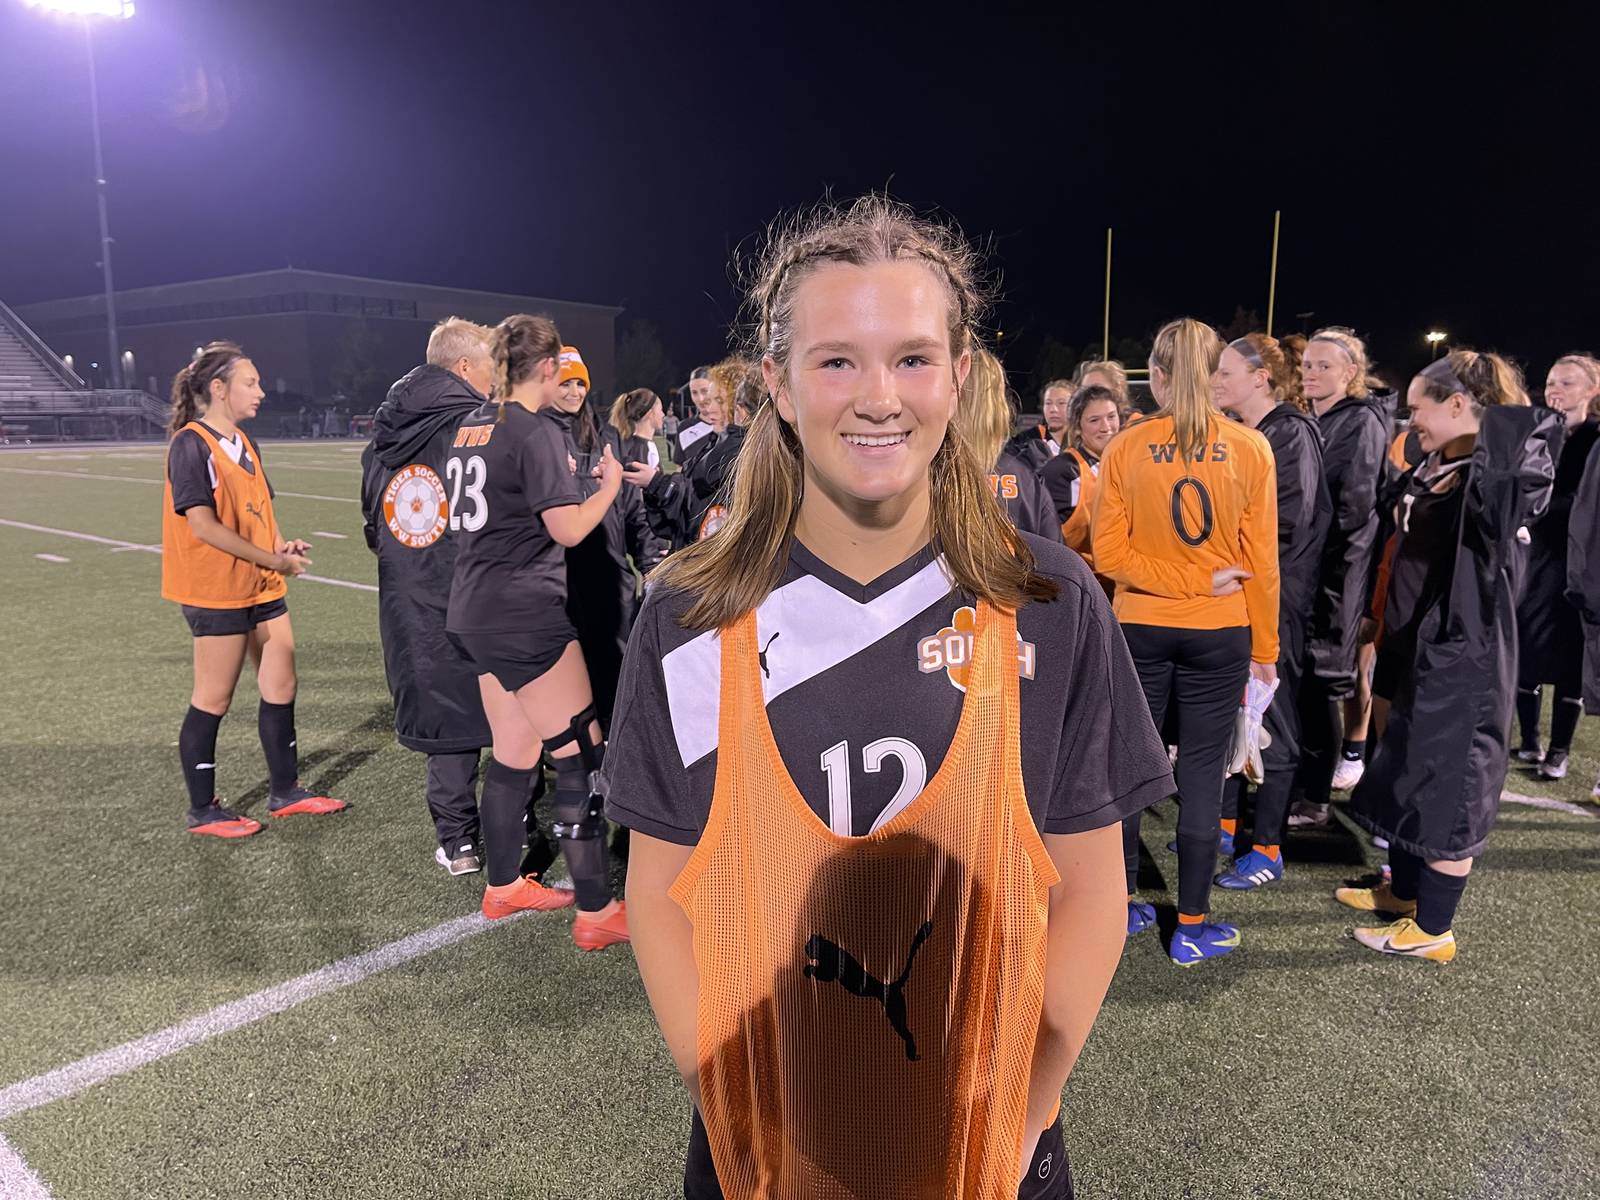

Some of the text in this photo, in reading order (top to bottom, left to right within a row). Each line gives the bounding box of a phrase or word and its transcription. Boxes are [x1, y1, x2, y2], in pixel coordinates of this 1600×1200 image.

[453, 423, 495, 448] WWS
[385, 466, 447, 503] TIGER SOCCER
[446, 455, 488, 532] 23
[410, 516, 446, 546] SOUTH
[1168, 475, 1215, 549] 0
[921, 633, 1033, 677] SOH
[820, 736, 927, 838] 12
